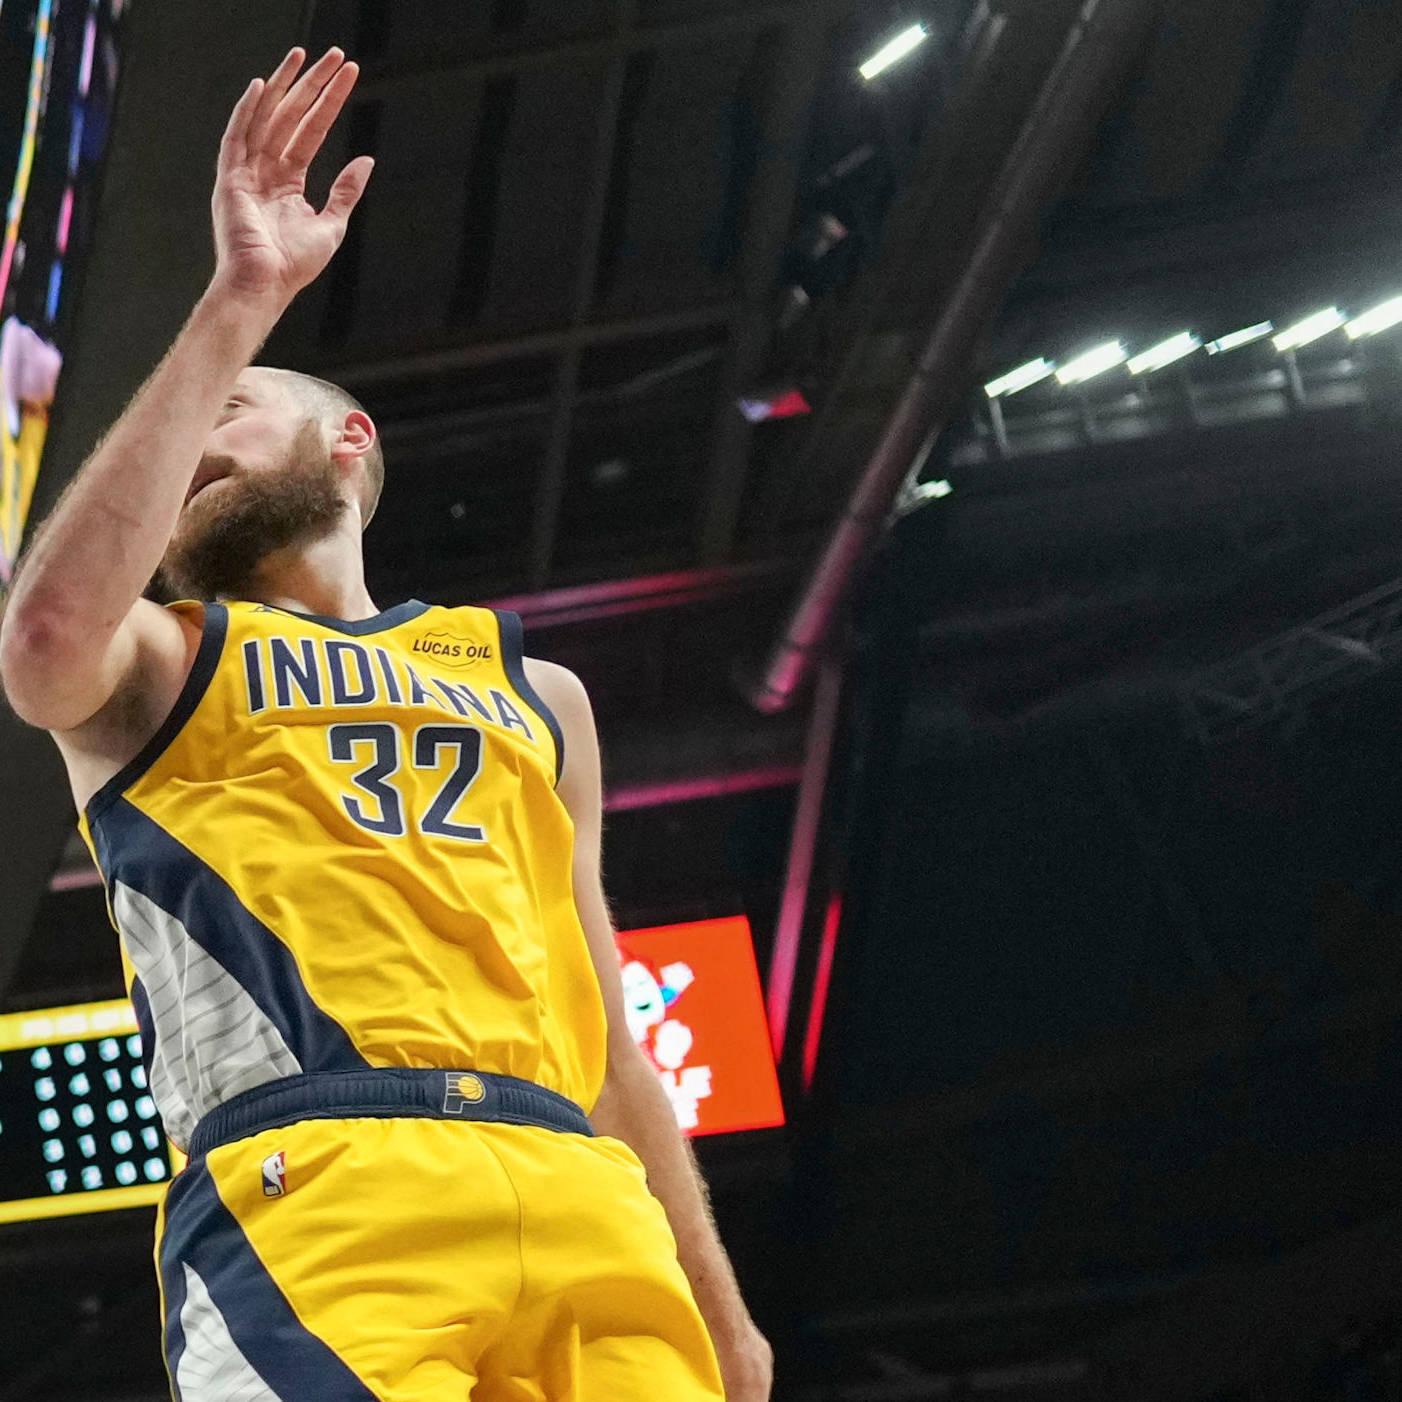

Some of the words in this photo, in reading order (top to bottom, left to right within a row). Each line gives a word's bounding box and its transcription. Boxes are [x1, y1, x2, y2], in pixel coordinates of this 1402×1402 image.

[240, 636, 538, 742] INDIANA
[412, 637, 461, 660] LUCAS
[464, 642, 492, 662] OIL
[326, 721, 486, 844] 32
